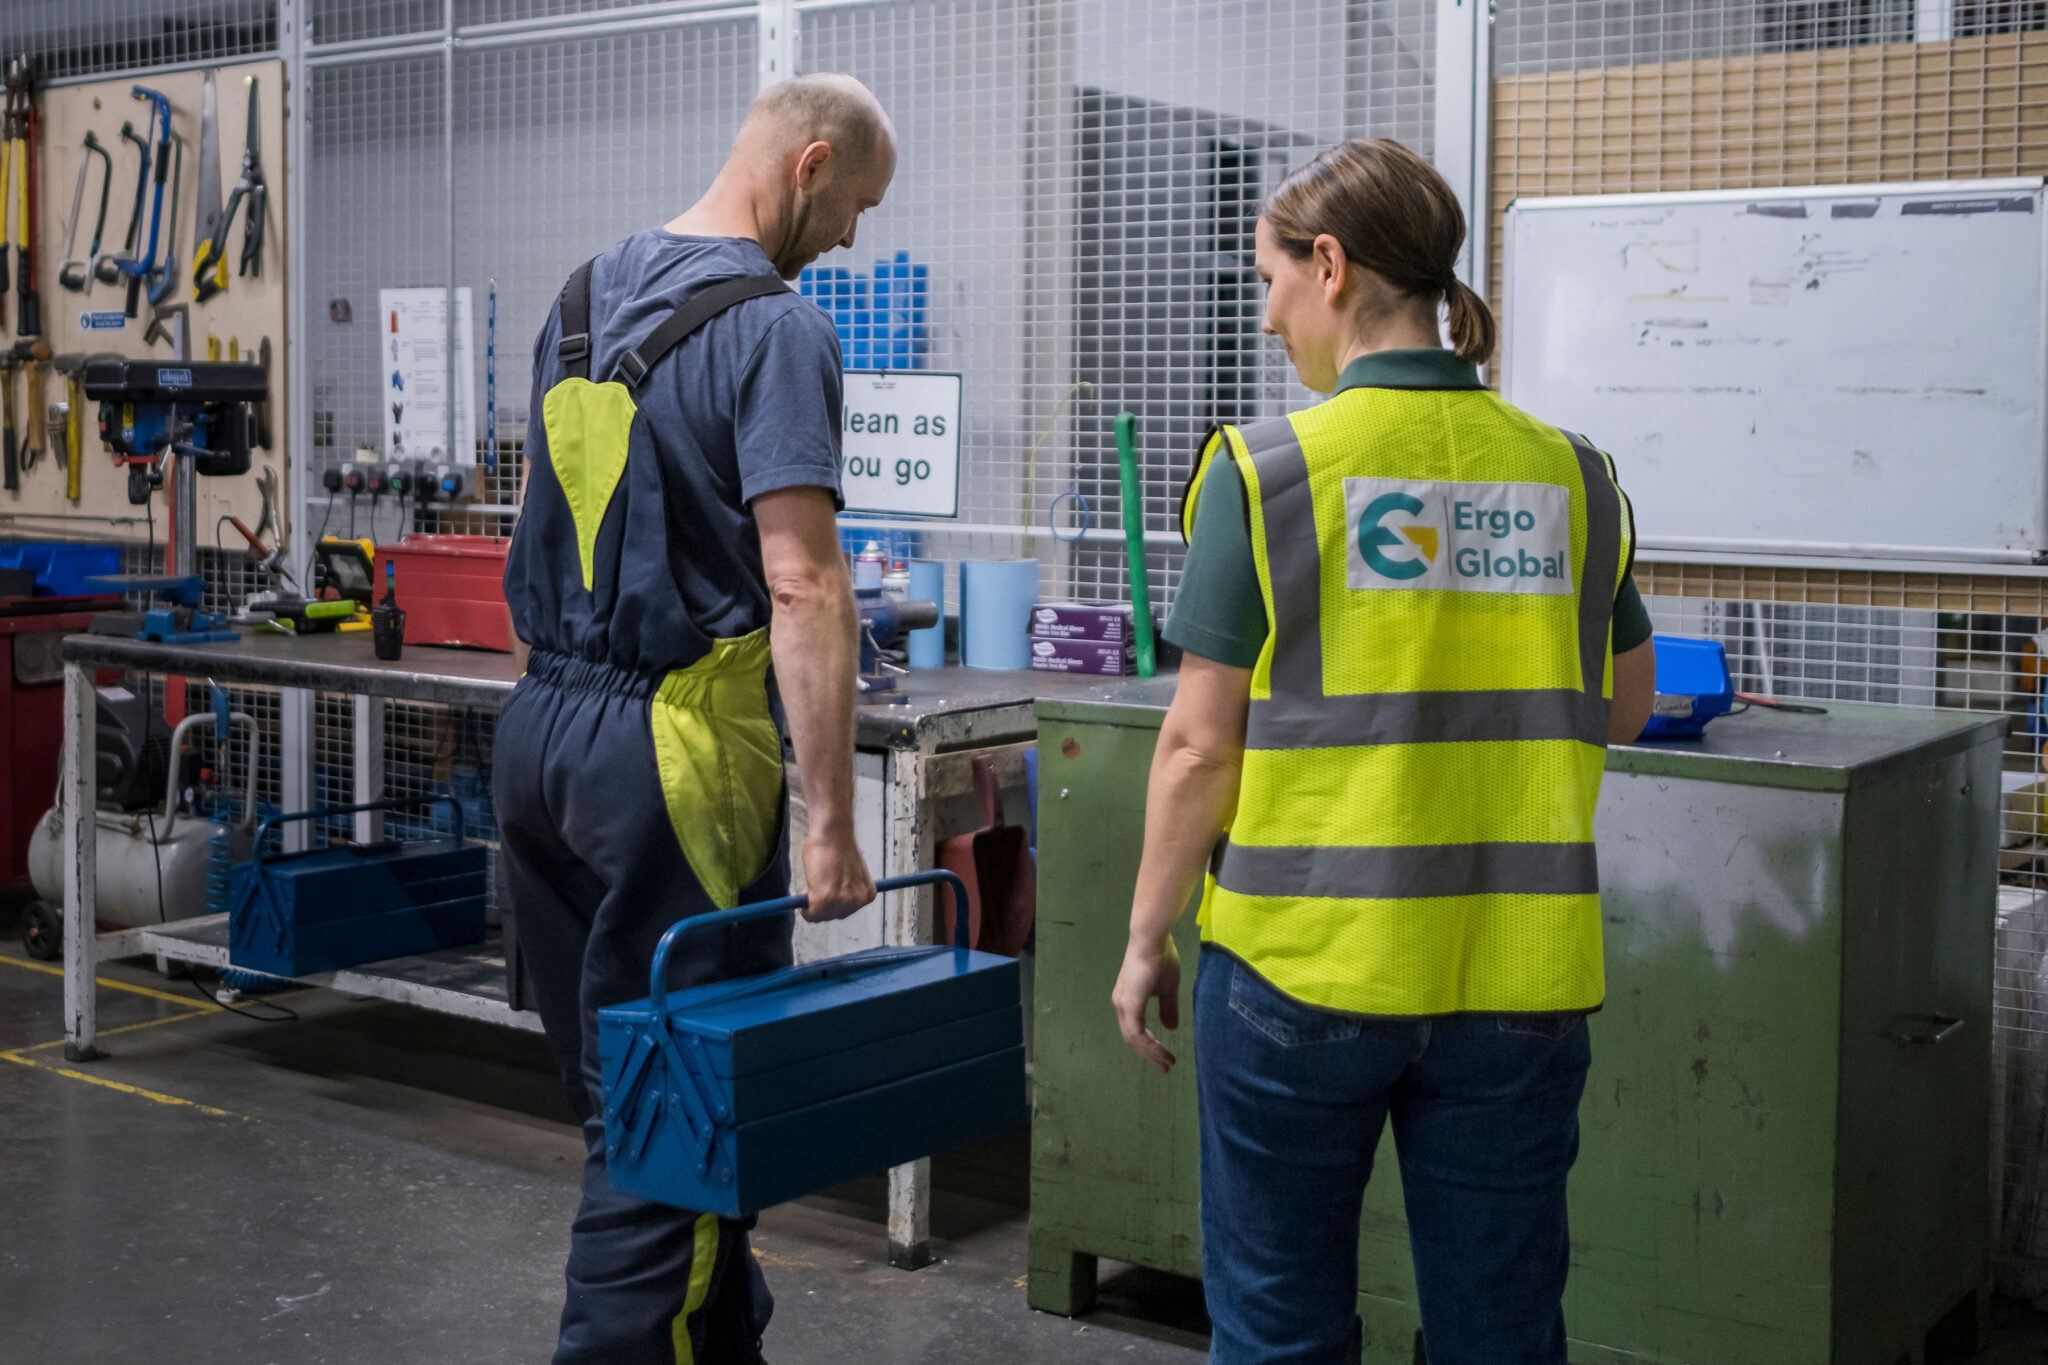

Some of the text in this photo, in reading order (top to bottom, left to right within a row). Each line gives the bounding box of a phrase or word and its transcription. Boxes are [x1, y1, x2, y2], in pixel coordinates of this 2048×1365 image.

[843, 405, 947, 437] lean as
[895, 458, 931, 486] go
[1454, 501, 1536, 539] Ergo
[1455, 547, 1565, 580] Global
